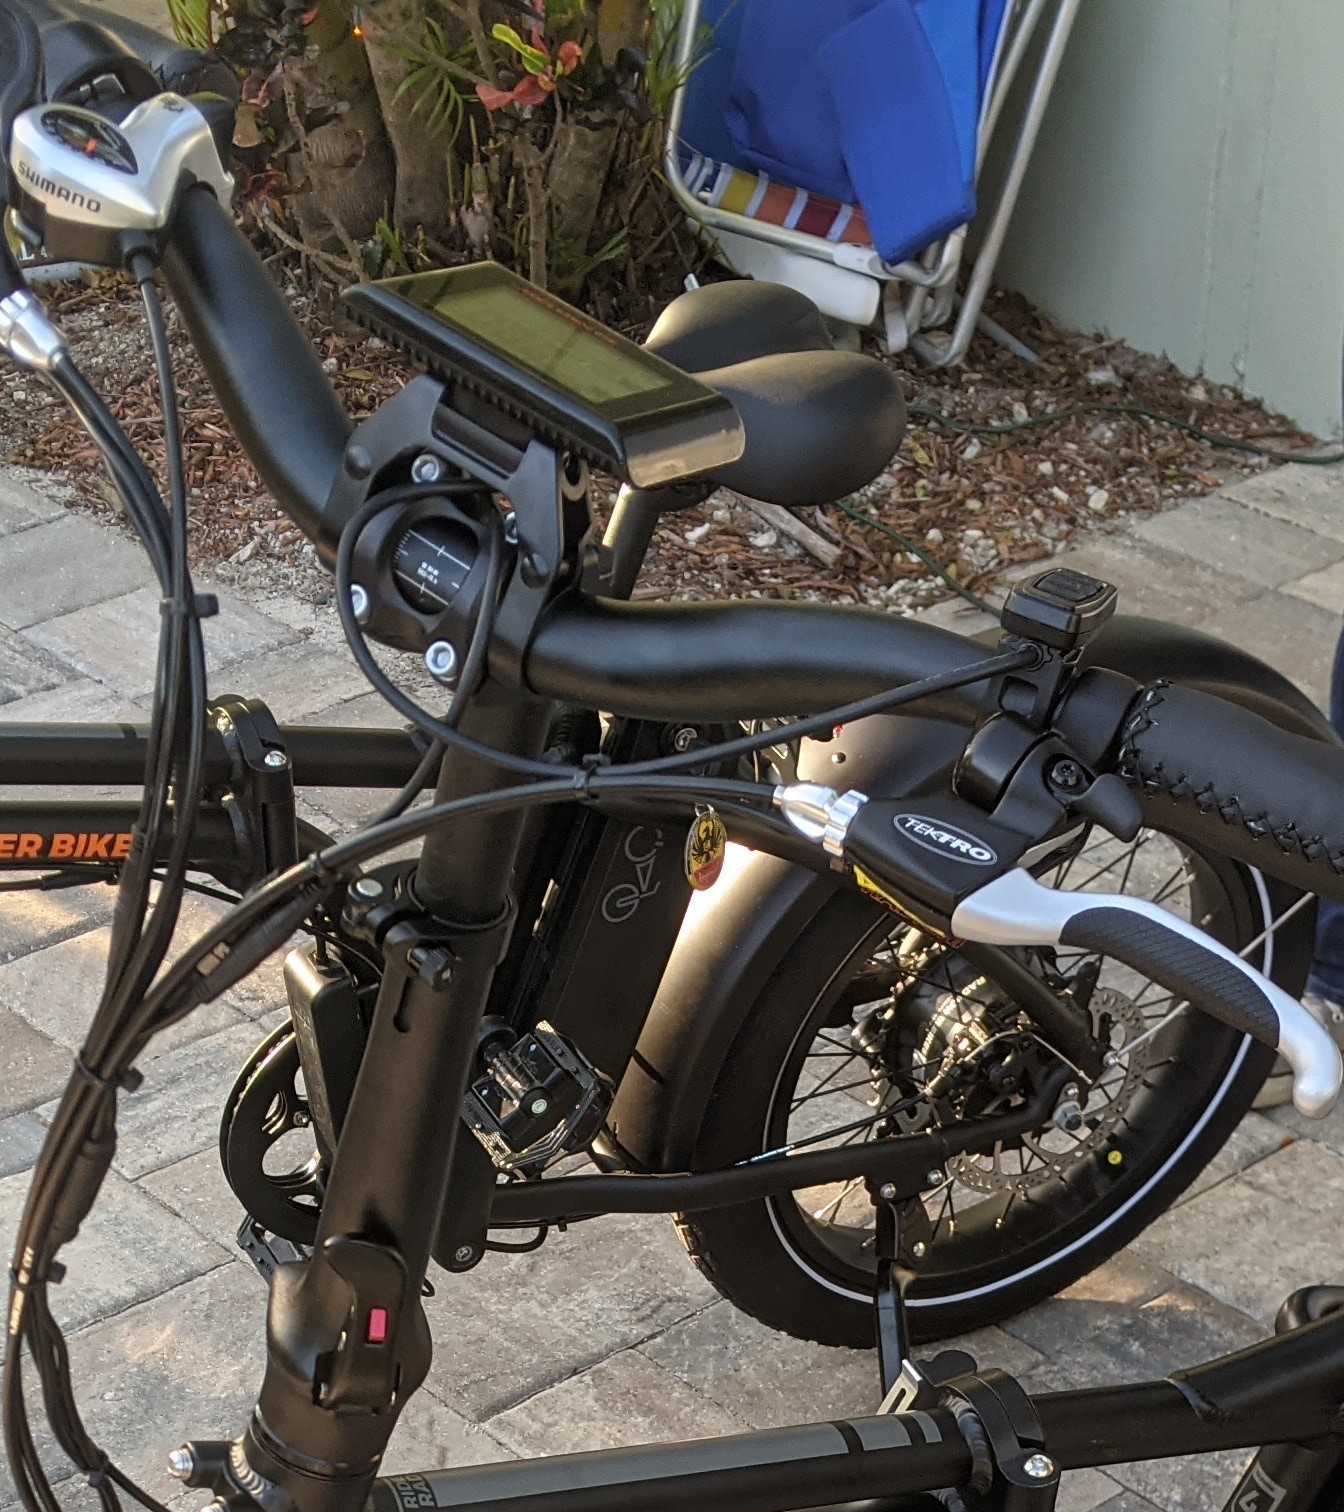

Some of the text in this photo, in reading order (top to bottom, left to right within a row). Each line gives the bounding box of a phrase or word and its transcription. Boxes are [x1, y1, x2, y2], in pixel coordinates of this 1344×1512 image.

[18, 160, 101, 213] SHIMANO
[48, 832, 134, 859] BIKE
[904, 817, 991, 860] TEKTRO
